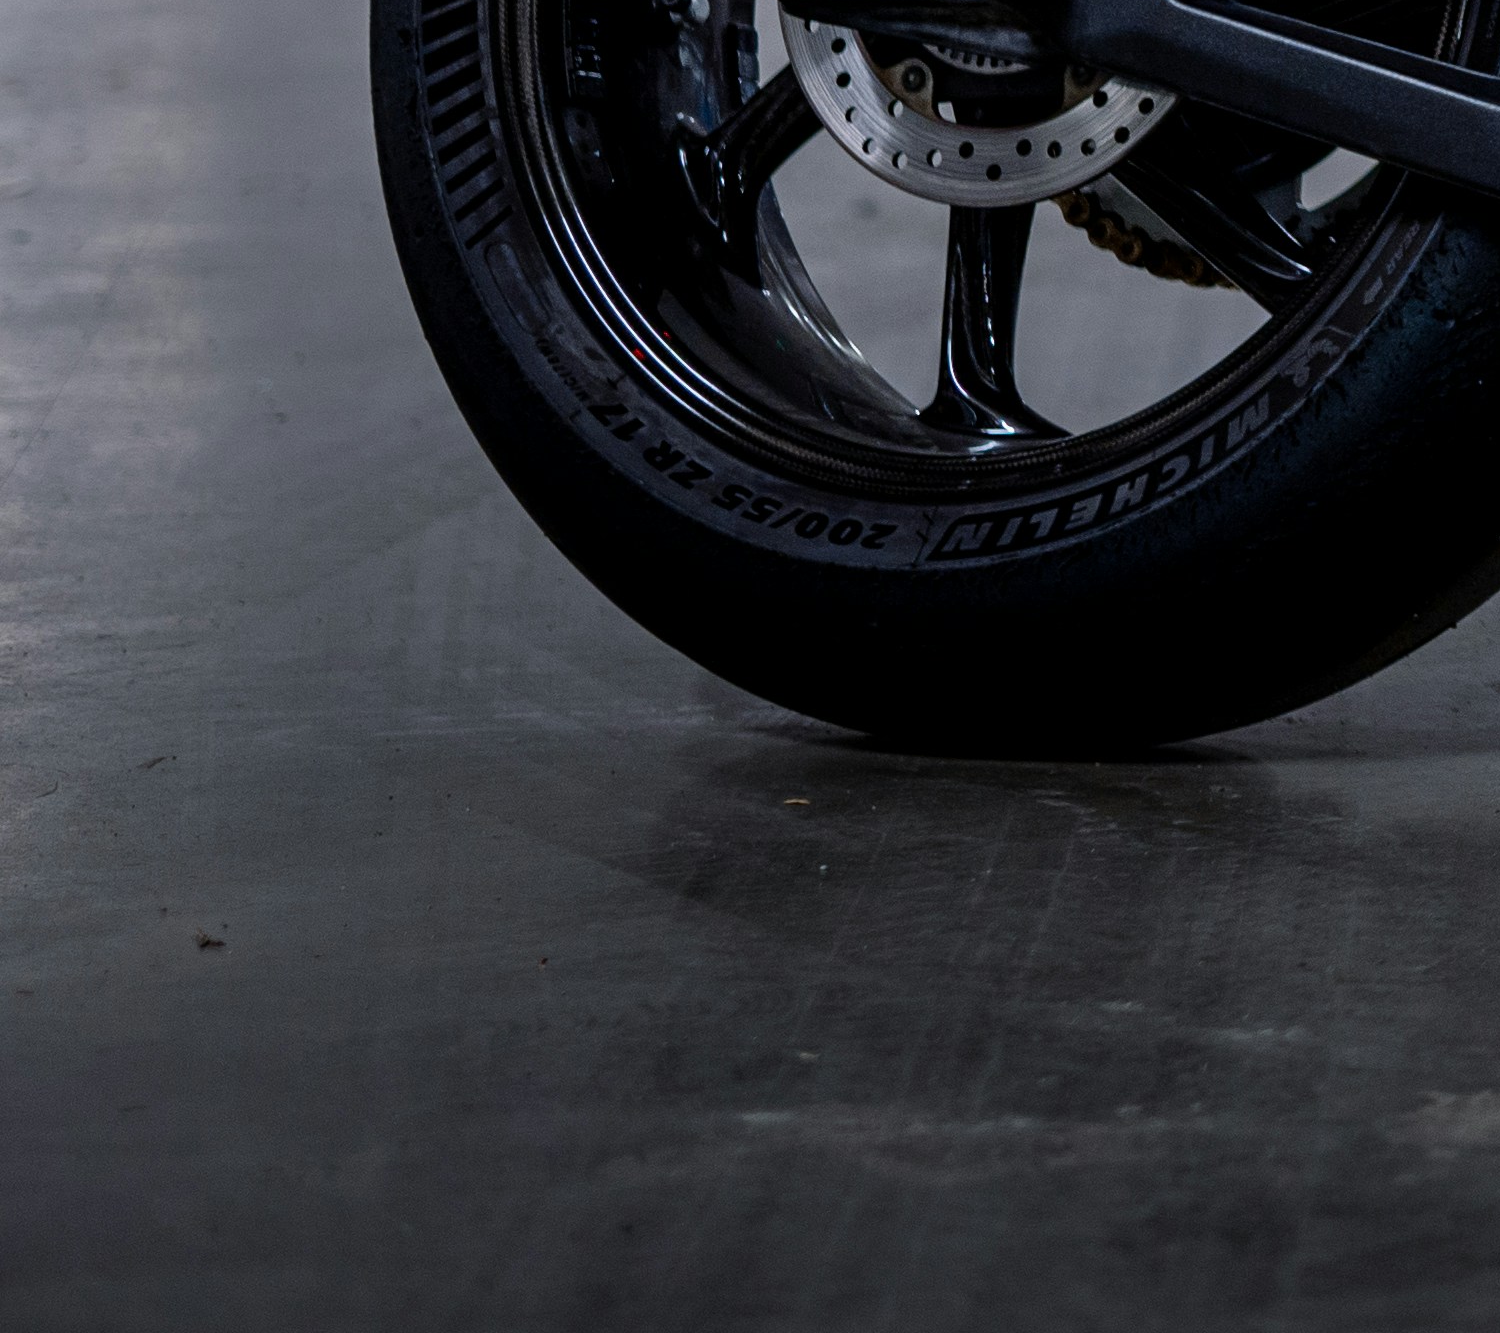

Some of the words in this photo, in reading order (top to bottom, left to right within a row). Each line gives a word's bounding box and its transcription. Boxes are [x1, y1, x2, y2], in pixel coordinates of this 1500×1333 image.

[587, 405, 642, 438] 17
[642, 439, 713, 490] ZR
[943, 391, 1272, 553] MICHELIN
[712, 483, 898, 551] 200/55
